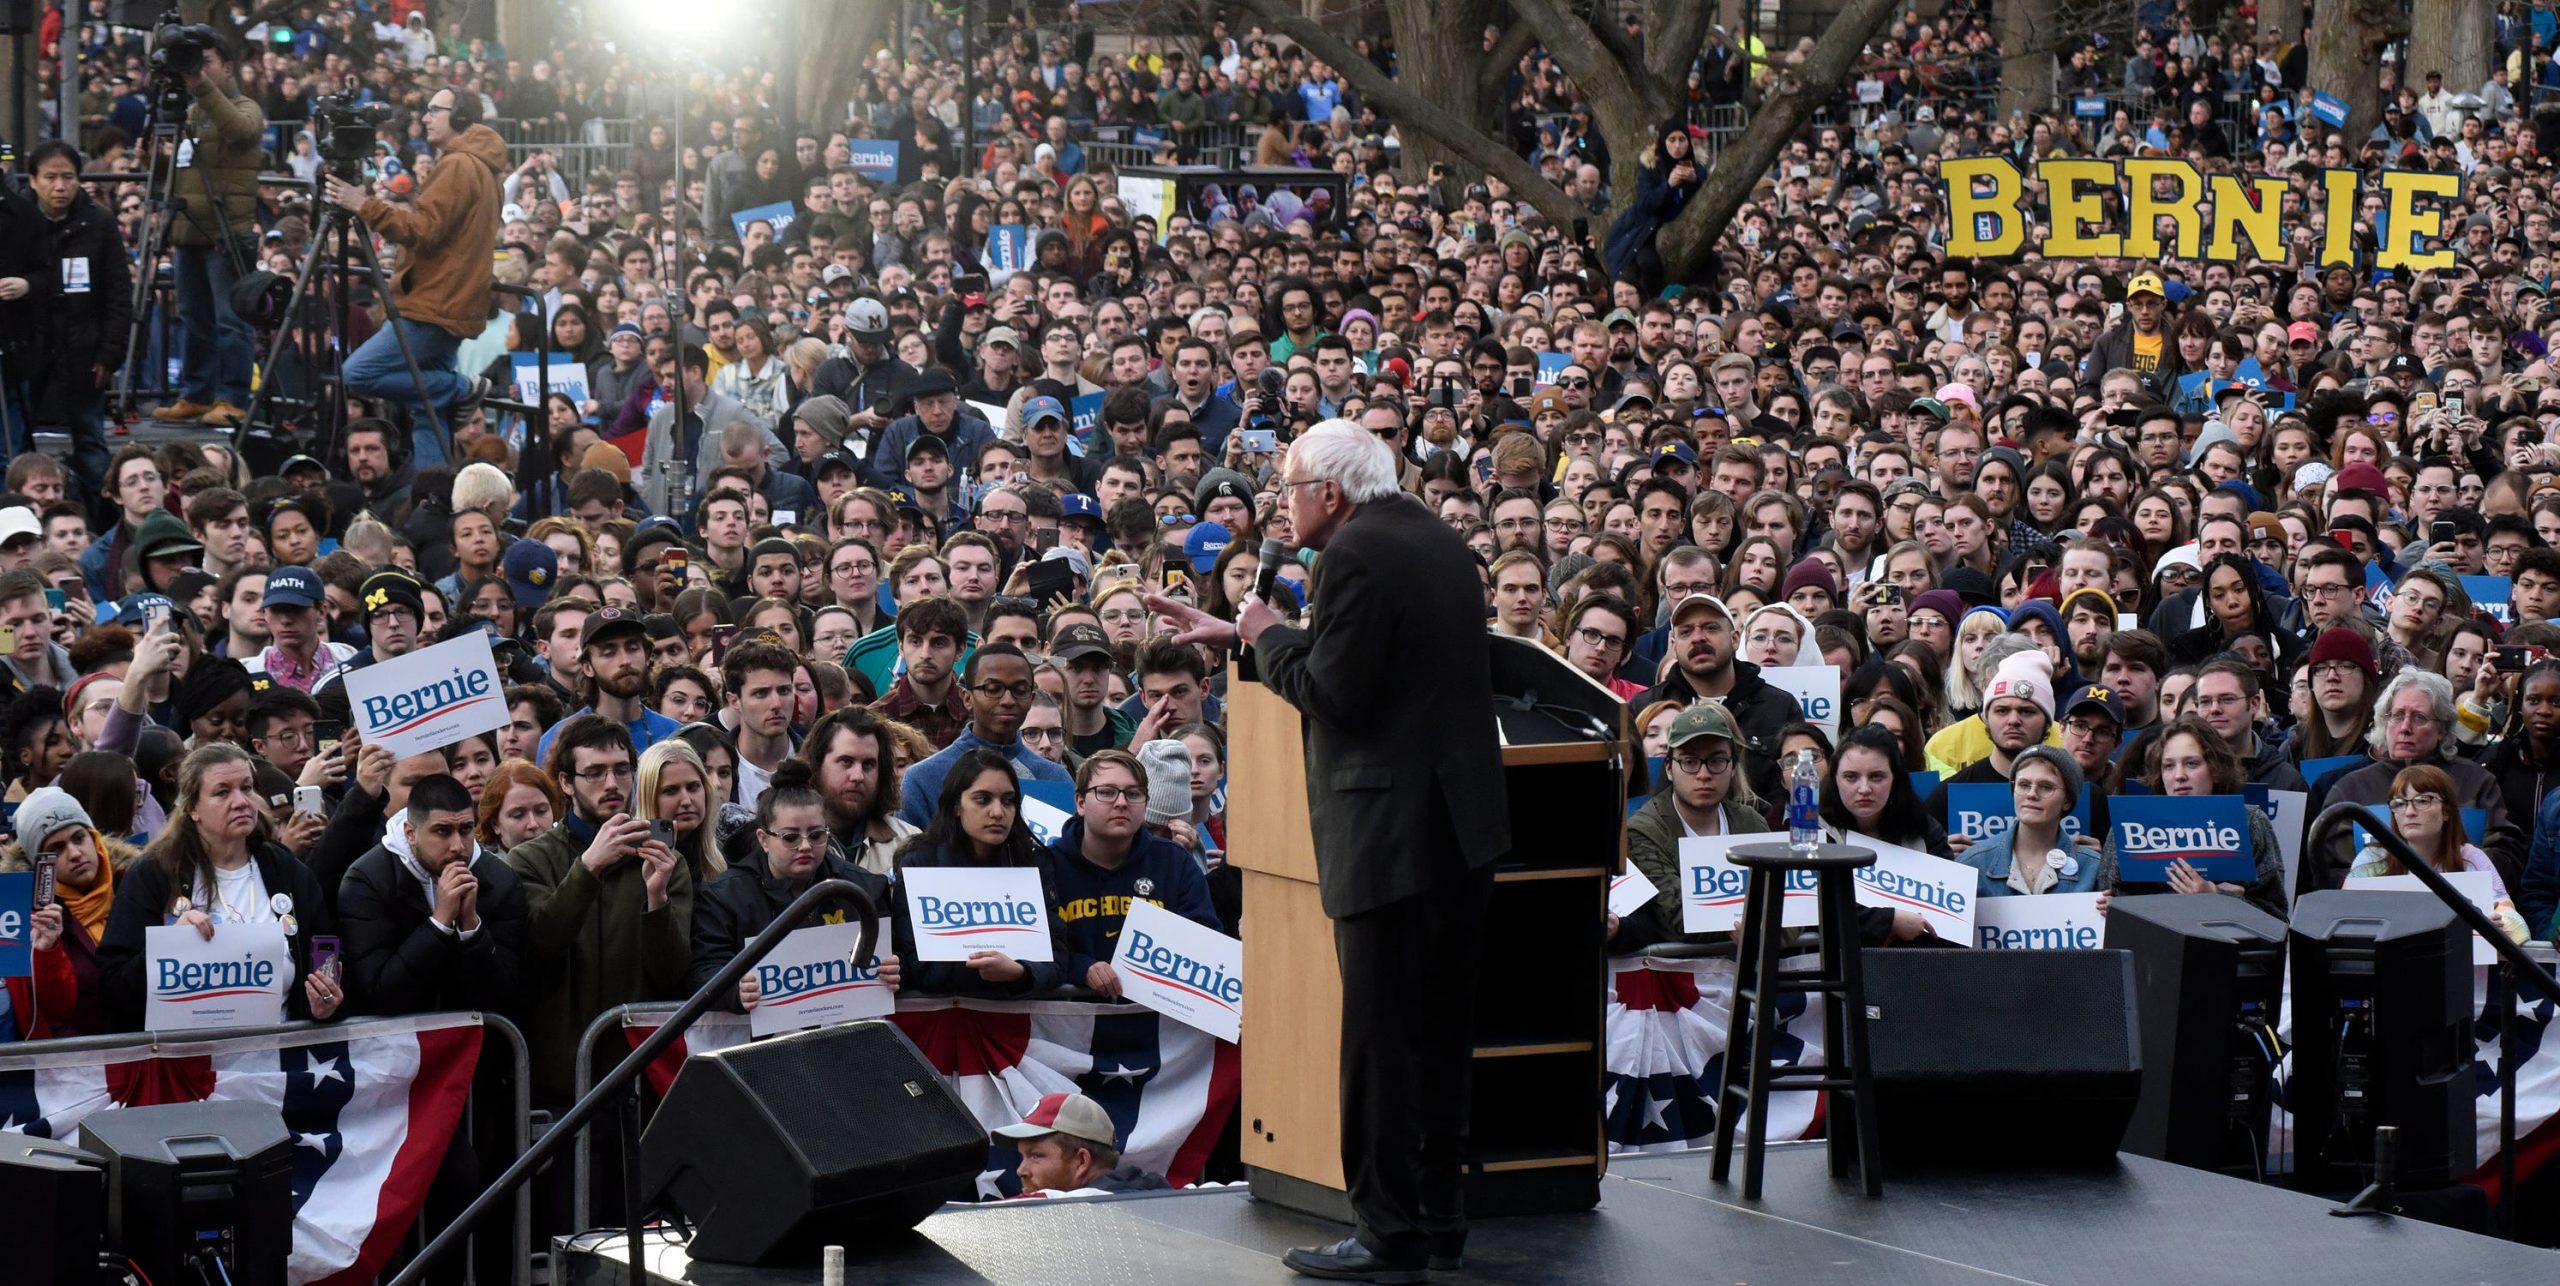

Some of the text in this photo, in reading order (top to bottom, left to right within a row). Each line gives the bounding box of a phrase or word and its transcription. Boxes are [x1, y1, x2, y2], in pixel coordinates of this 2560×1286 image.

[851, 151, 894, 167] ernie
[1940, 156, 2462, 270] BERNIE
[890, 491, 907, 503] M
[1077, 495, 1092, 510] T
[270, 577, 305, 590] MATH
[365, 588, 389, 612] M
[252, 679, 270, 691] M
[362, 667, 491, 730] Bernie
[2086, 686, 2110, 702] M
[1958, 811, 2081, 839] Bere
[2120, 819, 2240, 851] Bernie
[1855, 864, 1966, 914] Bernie
[822, 909, 846, 926] M
[918, 893, 1038, 927] Bernie
[1058, 895, 1165, 923] MICHIG
[1978, 919, 2097, 950] Bernie
[157, 952, 274, 991] Bernie
[757, 953, 881, 997] Bernie
[1125, 930, 1243, 1005] Bernie
